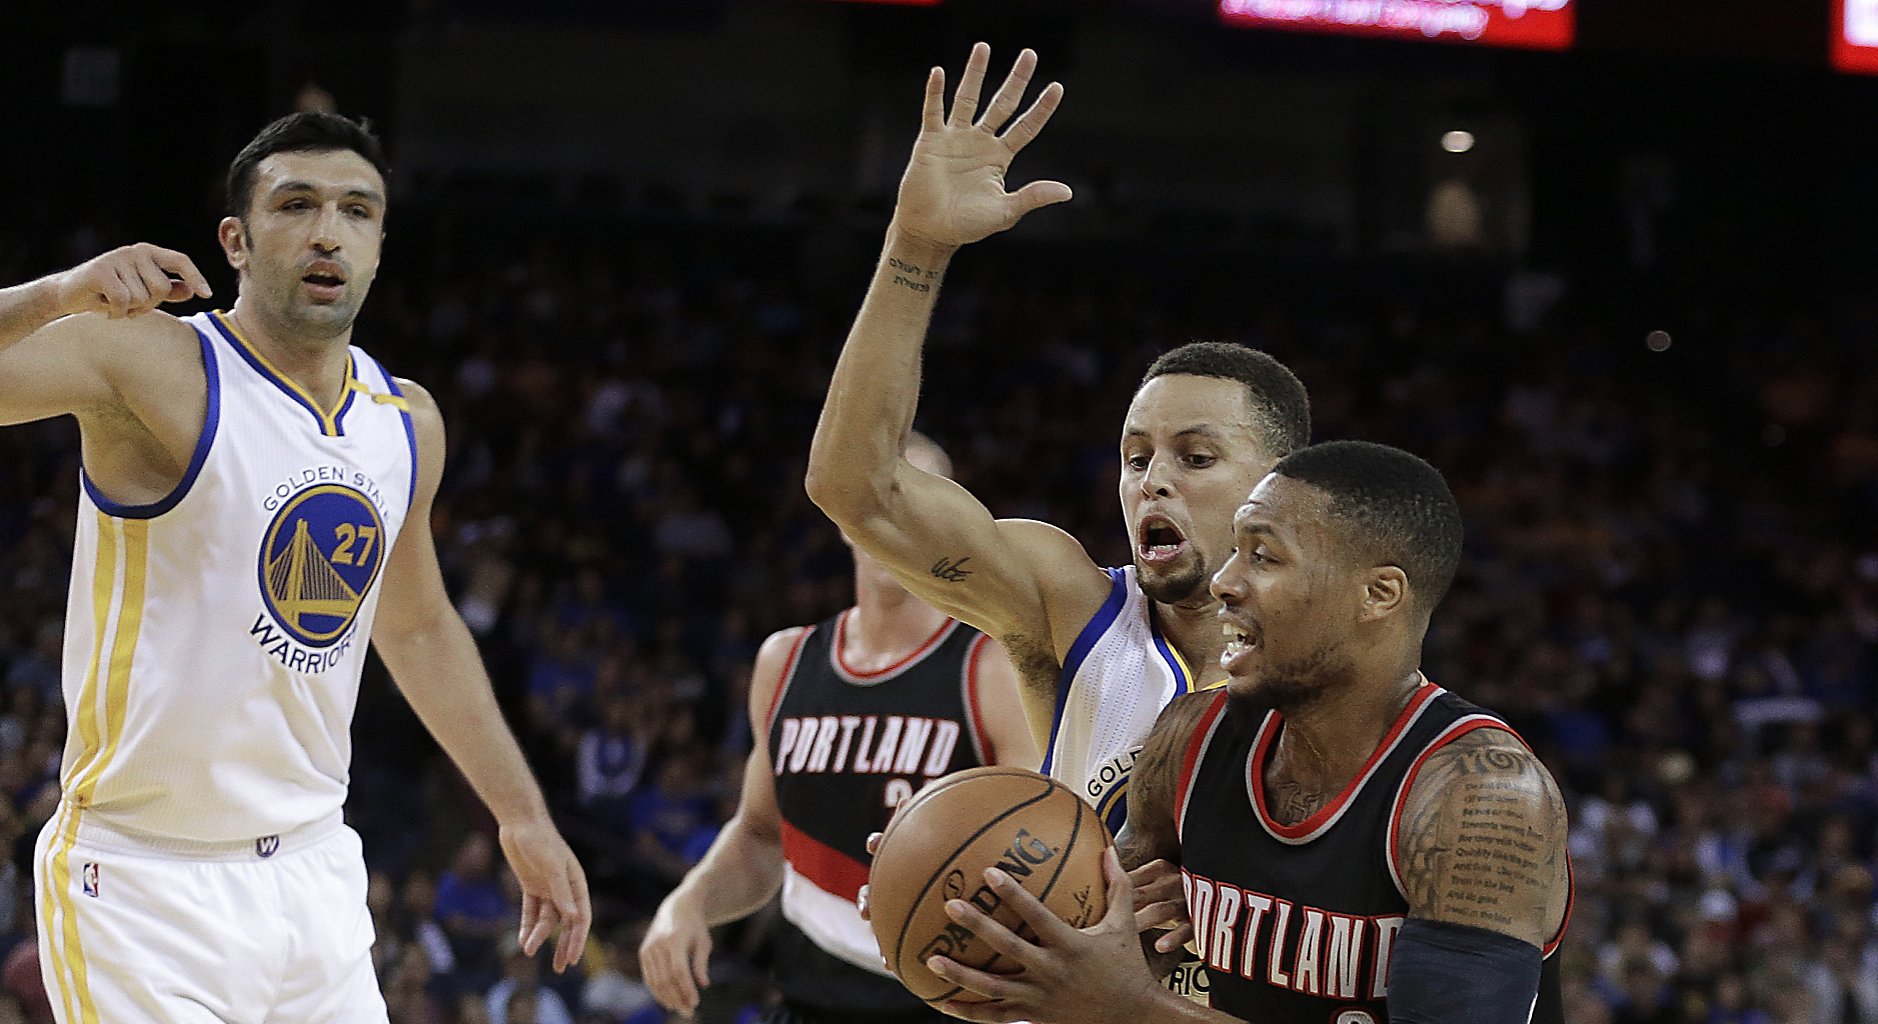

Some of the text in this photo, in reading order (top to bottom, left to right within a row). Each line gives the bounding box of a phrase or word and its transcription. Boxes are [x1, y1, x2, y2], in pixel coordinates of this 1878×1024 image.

[263, 466, 344, 512] GOLDEN
[331, 522, 377, 567] 27
[249, 612, 358, 674] WARRIOR
[775, 714, 960, 776] PORTLAND
[917, 828, 1054, 982] PADNG
